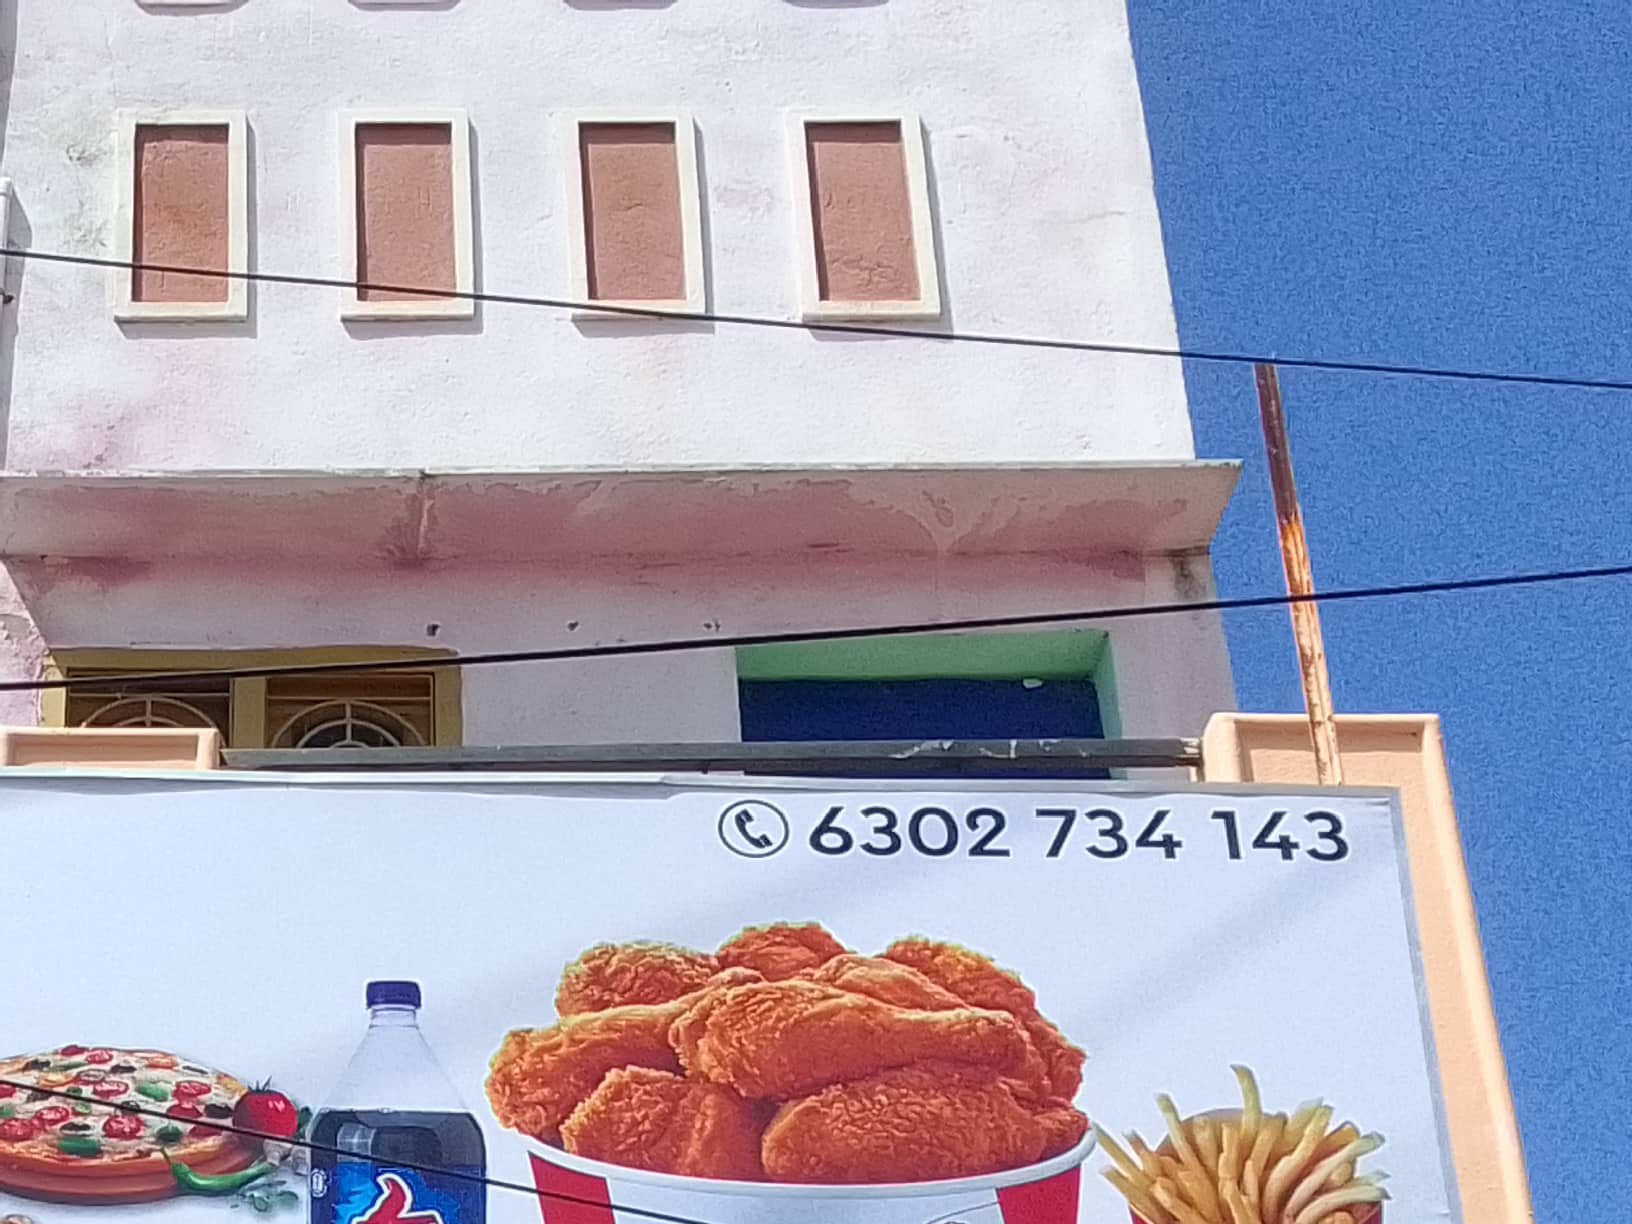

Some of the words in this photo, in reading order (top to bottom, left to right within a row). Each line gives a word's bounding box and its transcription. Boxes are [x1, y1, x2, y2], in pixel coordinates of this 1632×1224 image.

[809, 806, 1010, 857] 6302
[1035, 808, 1183, 859] 734
[1211, 809, 1349, 862] 143
